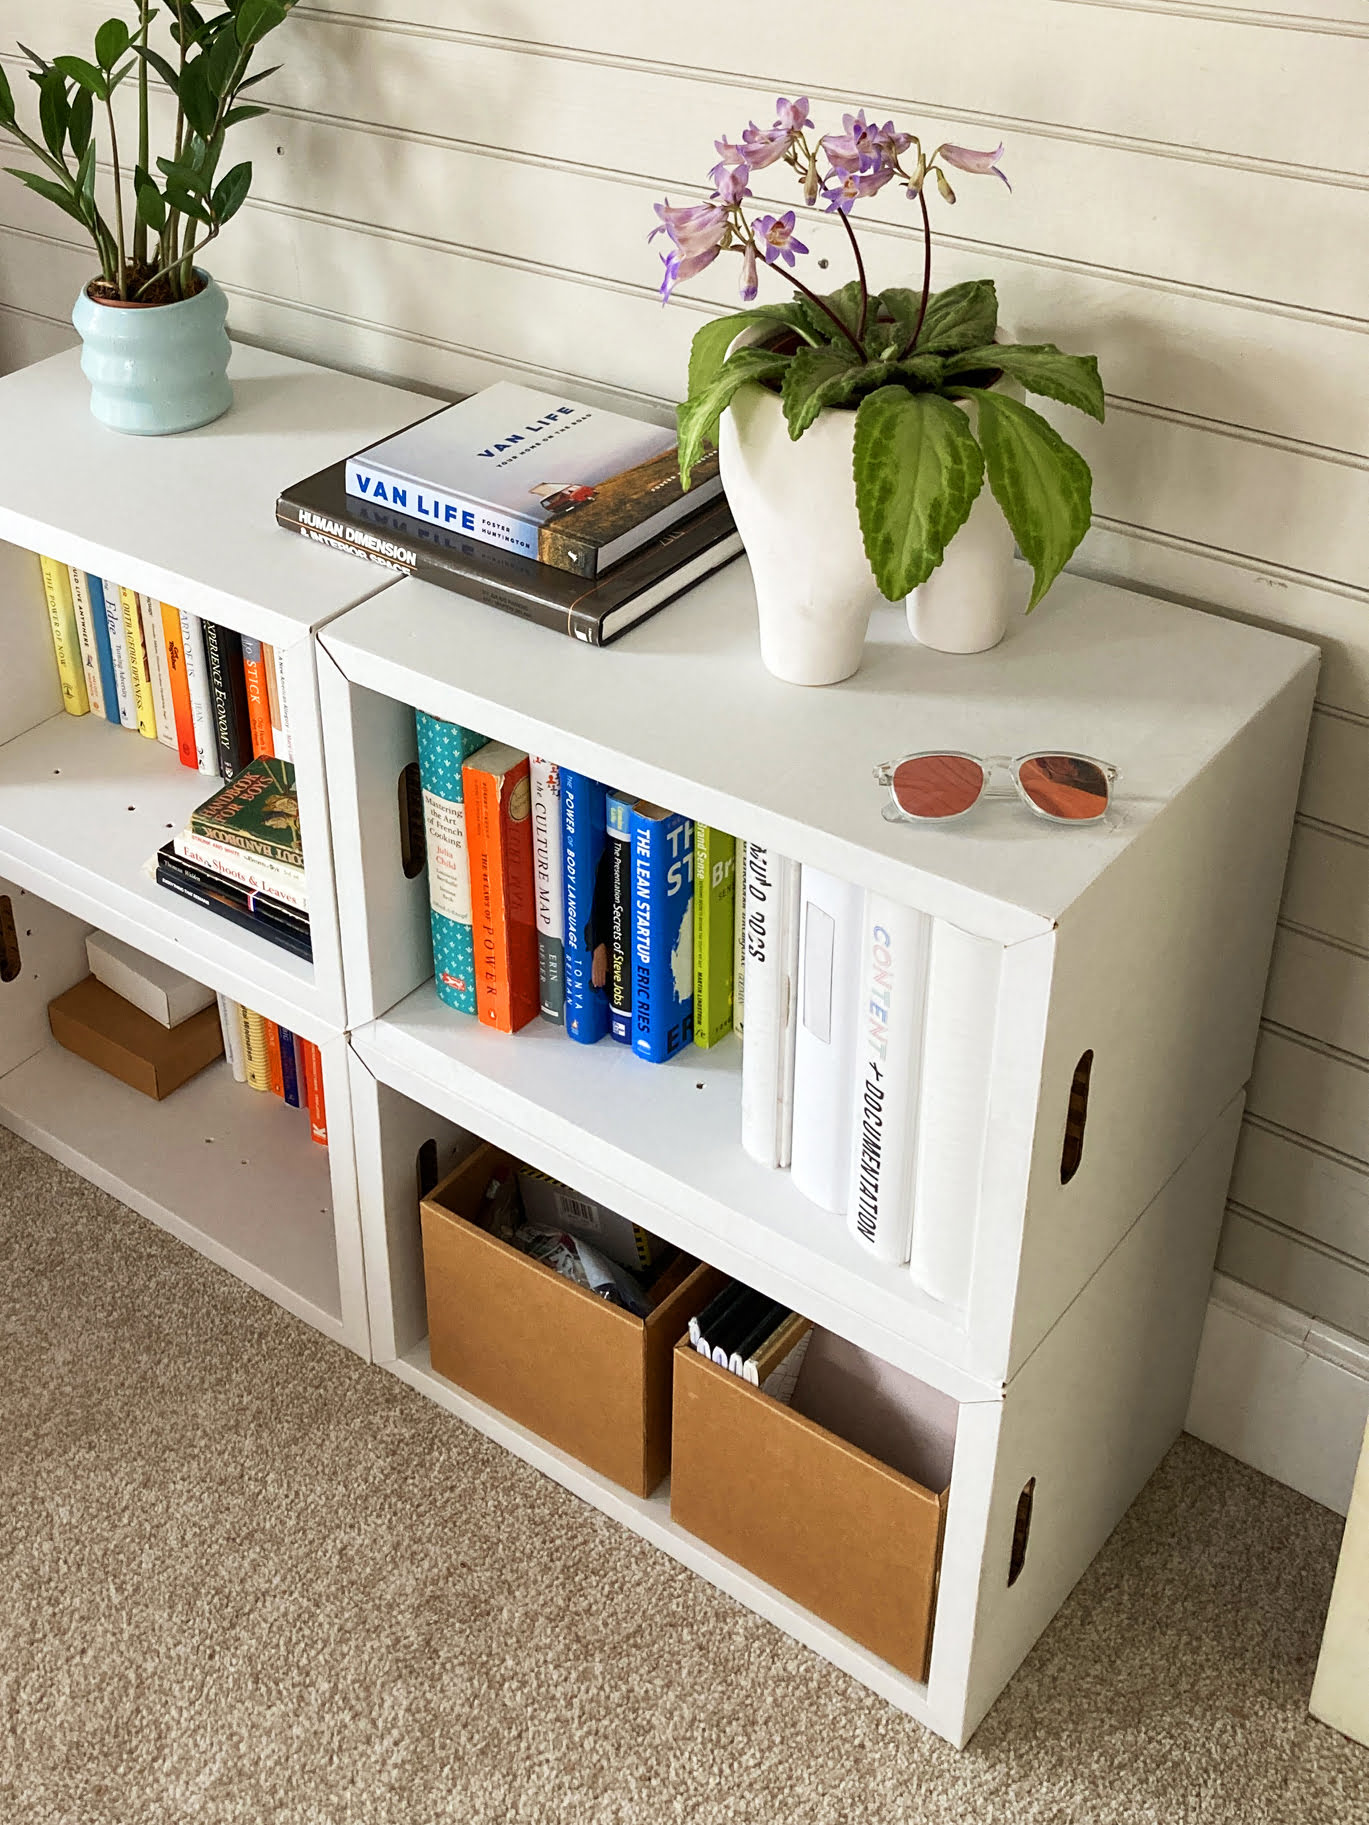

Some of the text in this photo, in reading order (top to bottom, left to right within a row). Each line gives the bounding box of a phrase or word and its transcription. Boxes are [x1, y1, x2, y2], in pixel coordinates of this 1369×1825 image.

[477, 406, 575, 458] VAN LIFE
[520, 442, 541, 455] HOME
[554, 425, 571, 434] THE
[356, 473, 475, 531] VAN LIFE
[299, 509, 417, 567] HUMAN DIMENSION
[482, 519, 511, 533] FOSTER
[482, 528, 531, 549] HUNTINGTON
[300, 527, 411, 576] & INTERIOR SPACE
[45, 572, 67, 666] THE POWER OF NOW
[78, 606, 89, 648] ANYWHERE
[105, 599, 118, 635] Edge
[168, 641, 177, 671] Together
[119, 671, 128, 699] Adversity
[131, 663, 144, 711] OPENNESS
[247, 660, 261, 704] STICK
[215, 687, 230, 749] ECONOMY
[201, 772, 260, 817] HANDBOOK
[214, 775, 274, 824] FOR BOYS
[425, 795, 463, 819] Mastering
[565, 791, 575, 834] POWER
[427, 817, 463, 837] of French
[431, 808, 457, 825] the Art
[201, 826, 272, 856] HANDBOOK
[429, 827, 462, 848] Cooking
[437, 845, 454, 859] Julia
[535, 801, 550, 883] CULTURE
[614, 842, 622, 857] The
[212, 859, 247, 882] Shoots
[249, 876, 260, 887] &
[262, 881, 298, 904] Leaves
[436, 855, 457, 871] Child
[566, 849, 576, 884] BODY
[613, 857, 622, 904] Presentation
[697, 851, 707, 880] Sense
[484, 909, 491, 920] OF
[539, 890, 551, 926] MAP
[566, 884, 578, 950] LANGUAGE
[613, 903, 624, 944] Secrets
[613, 942, 624, 955] of
[636, 829, 650, 1034] THE LEAN STARTUP ERIC RIES
[483, 923, 498, 996] POWER
[539, 944, 547, 983] MEYER
[548, 953, 559, 982] ERIN
[565, 953, 574, 1006] REIMAN
[613, 951, 624, 982] Steve
[573, 960, 583, 1010] TONYA
[613, 982, 625, 1006] Jobs
[868, 925, 894, 1063] CONTENT
[243, 1021, 254, 1062] Minimalism
[856, 1079, 885, 1244] DOCUMENTATION
